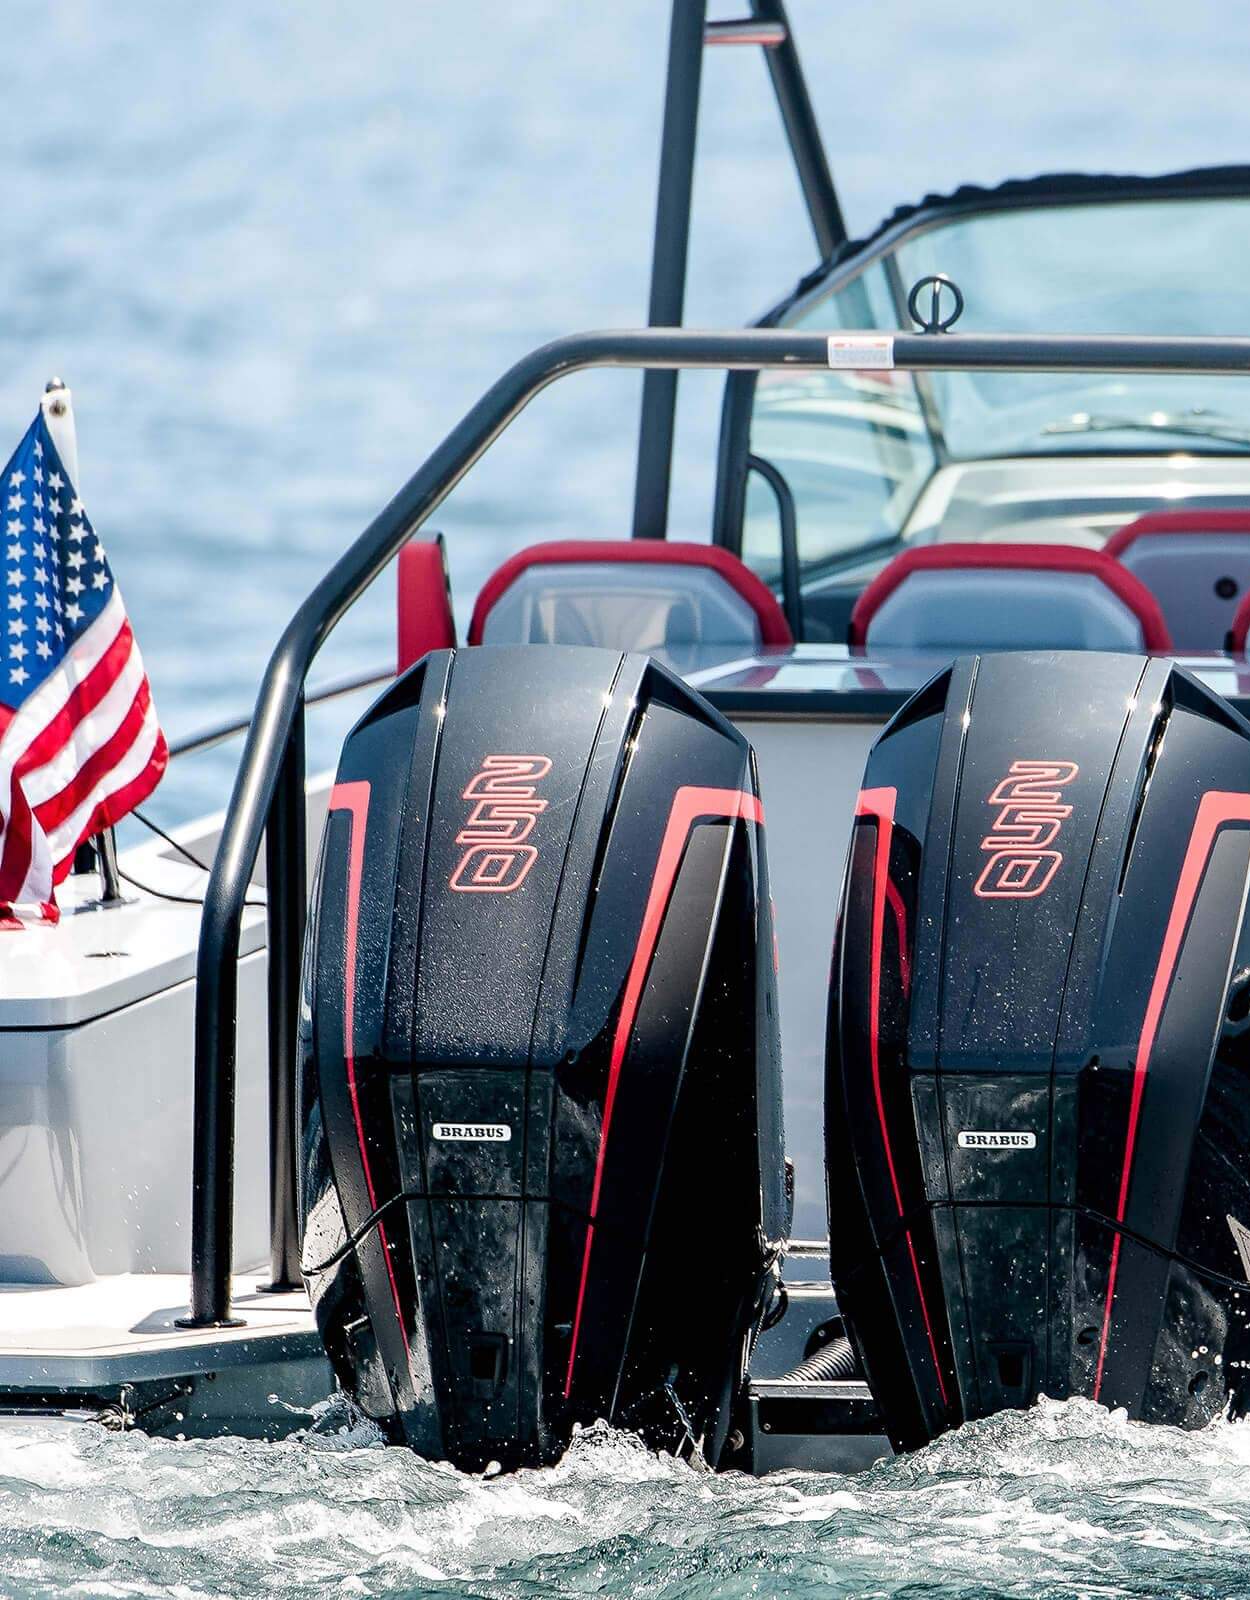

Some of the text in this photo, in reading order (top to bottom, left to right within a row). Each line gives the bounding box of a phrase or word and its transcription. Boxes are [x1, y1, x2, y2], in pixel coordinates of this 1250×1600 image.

[449, 754, 553, 893] 250
[973, 760, 1080, 899] 250
[439, 1126, 505, 1139] BRABUS
[964, 1134, 1030, 1147] BRABUS
